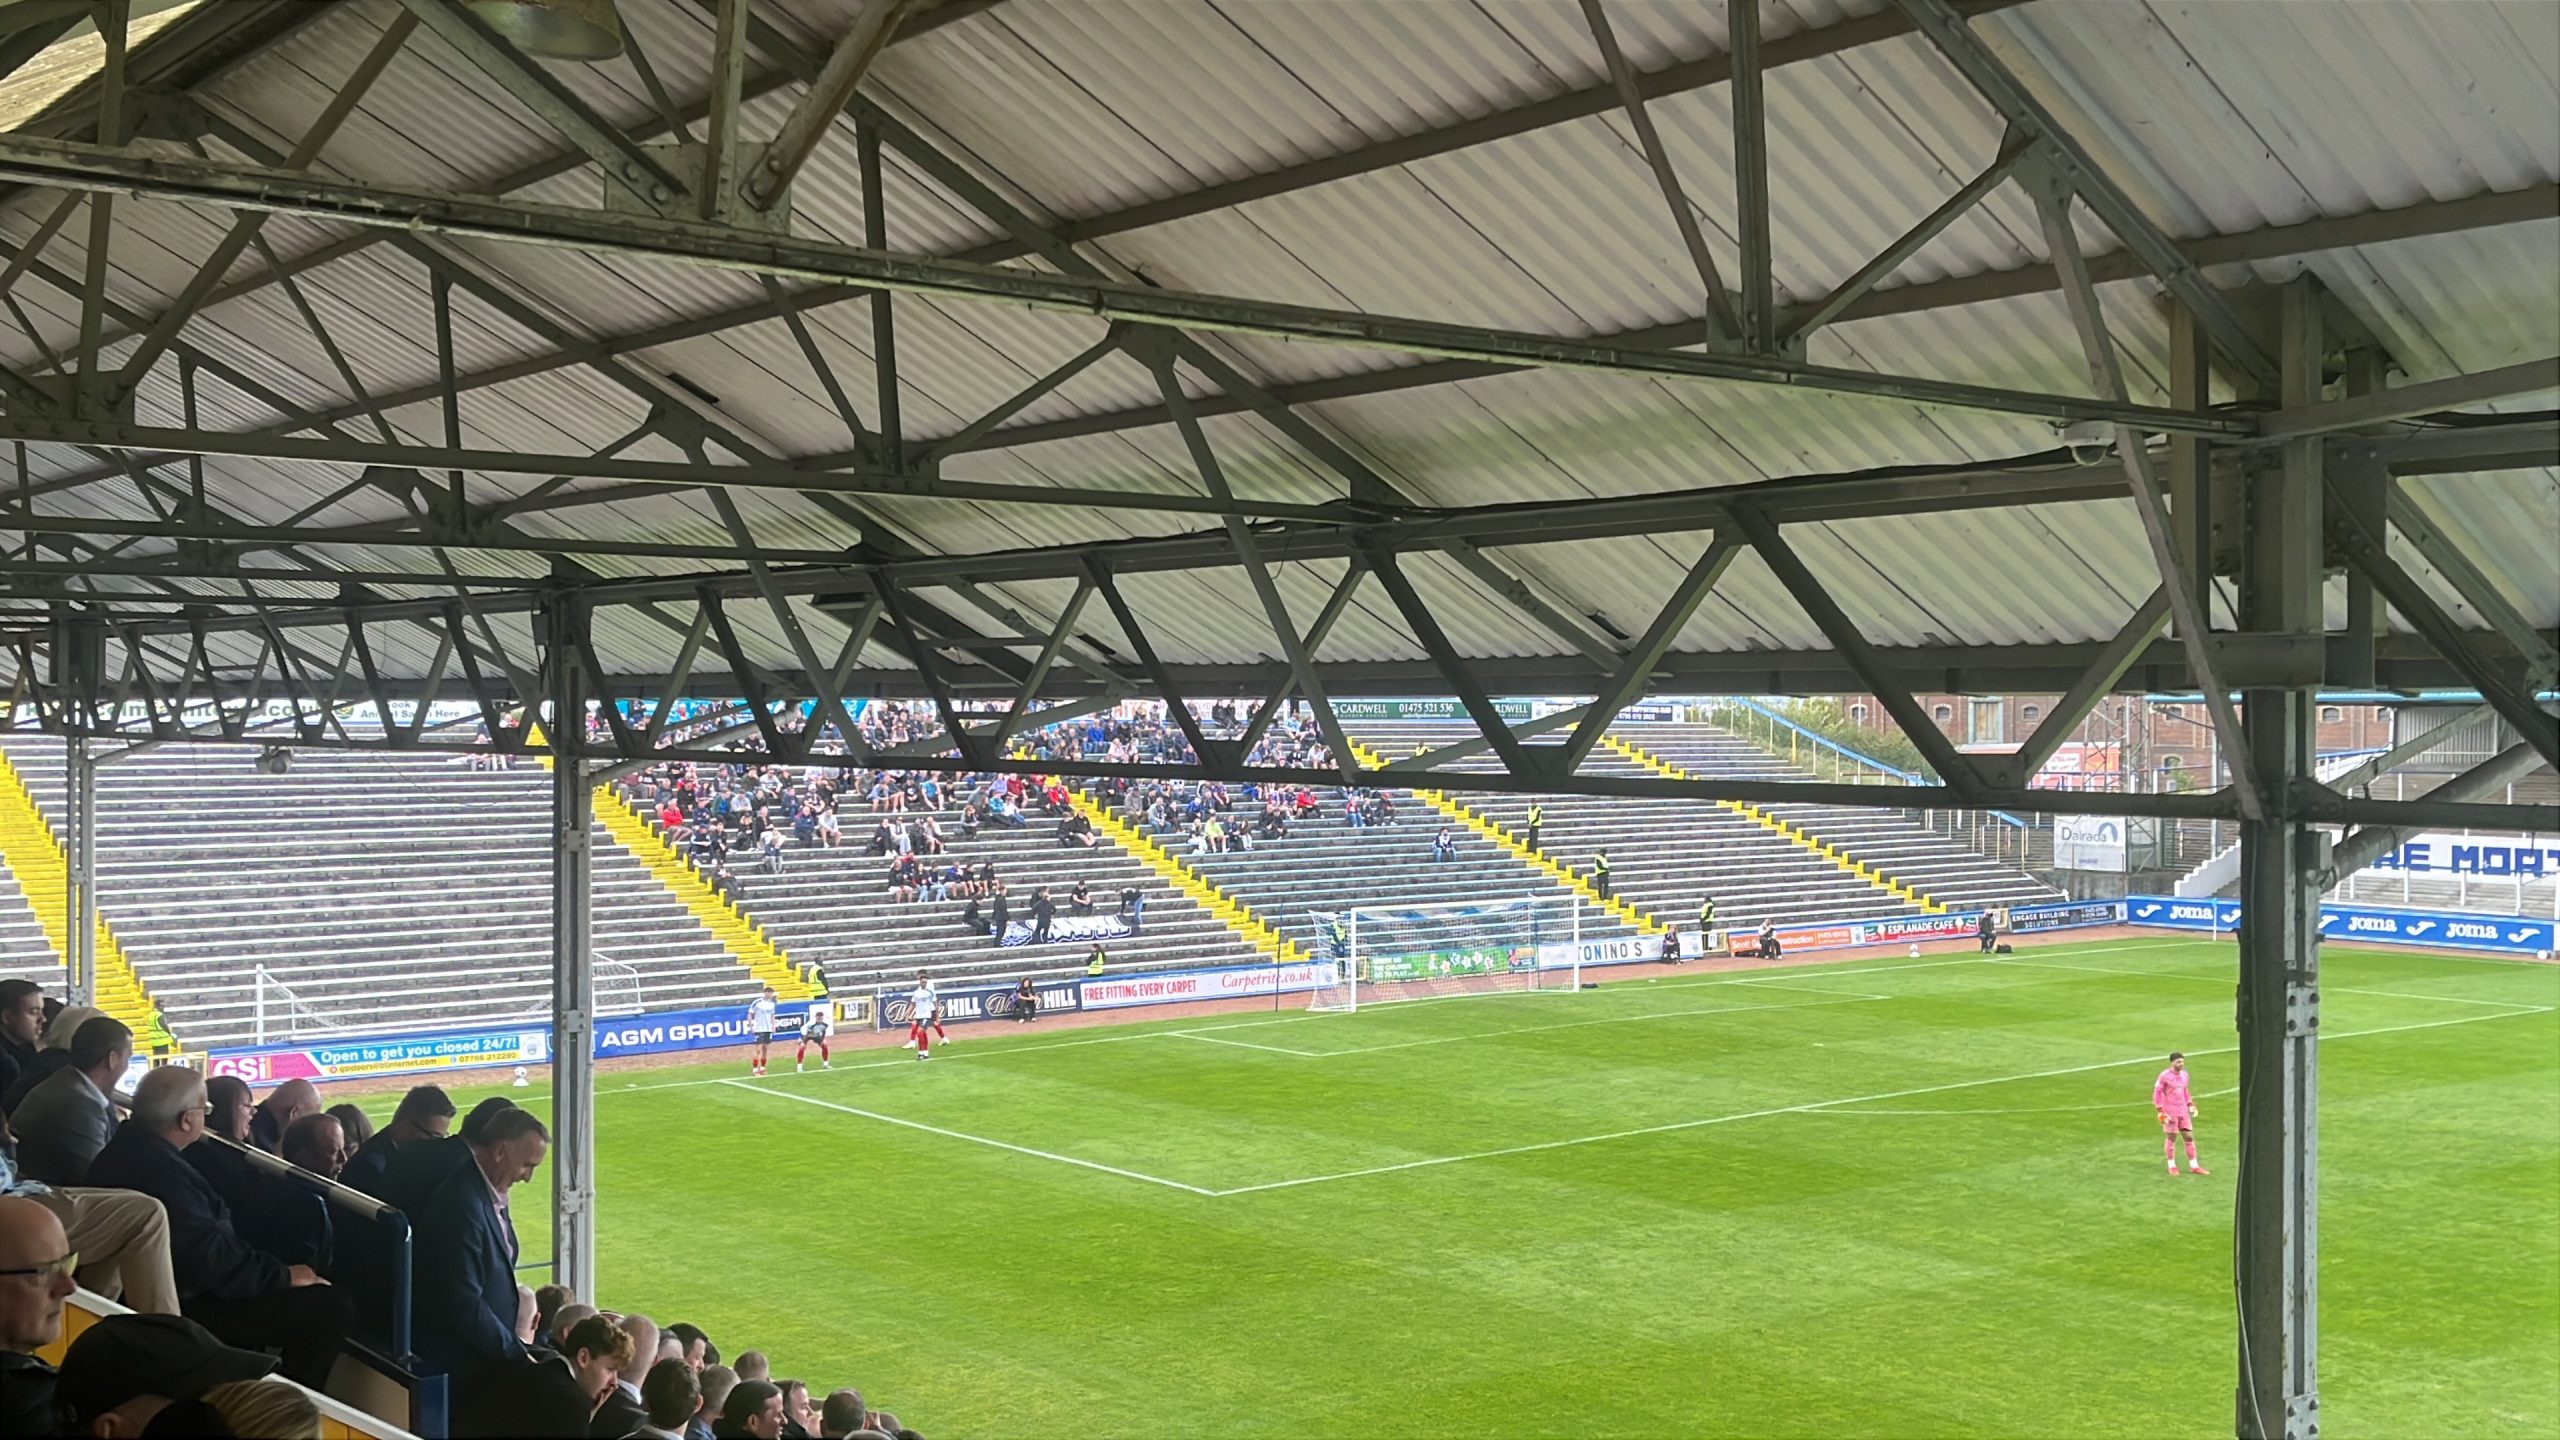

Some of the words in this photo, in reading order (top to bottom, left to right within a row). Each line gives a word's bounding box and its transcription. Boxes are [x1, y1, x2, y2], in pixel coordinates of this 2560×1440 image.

[360, 709, 398, 719] Anil
[435, 710, 460, 718] Here
[1339, 703, 1387, 714] CARDWELL
[1399, 703, 1422, 713] 01475
[1424, 703, 1437, 713] 521
[1440, 703, 1454, 713] 536
[1494, 703, 1528, 714] RDWELL
[2061, 826, 2107, 842] Dalrada
[2012, 913, 2038, 922] ENGAGE
[2039, 910, 2070, 920] BUILDING
[1887, 920, 1933, 935] ESPLANADE
[1779, 935, 1814, 945] onstruction
[1221, 967, 1313, 992] Carpetrite.co.uk
[1084, 985, 1104, 1001] FREE
[1106, 983, 1137, 999] FITTING
[1139, 982, 1164, 997] EVERY
[1167, 979, 1197, 995] CARPET
[1043, 988, 1077, 1009] HILL
[846, 1002, 857, 1012] 13
[947, 996, 982, 1017] HILL
[601, 1023, 664, 1048] AGM
[320, 1049, 360, 1064] Open
[362, 1047, 377, 1060] to
[380, 1046, 405, 1061] get
[406, 1045, 432, 1059] you
[434, 1039, 479, 1055] closed
[482, 1037, 517, 1051] 24/7!
[213, 1056, 267, 1082] GSi
